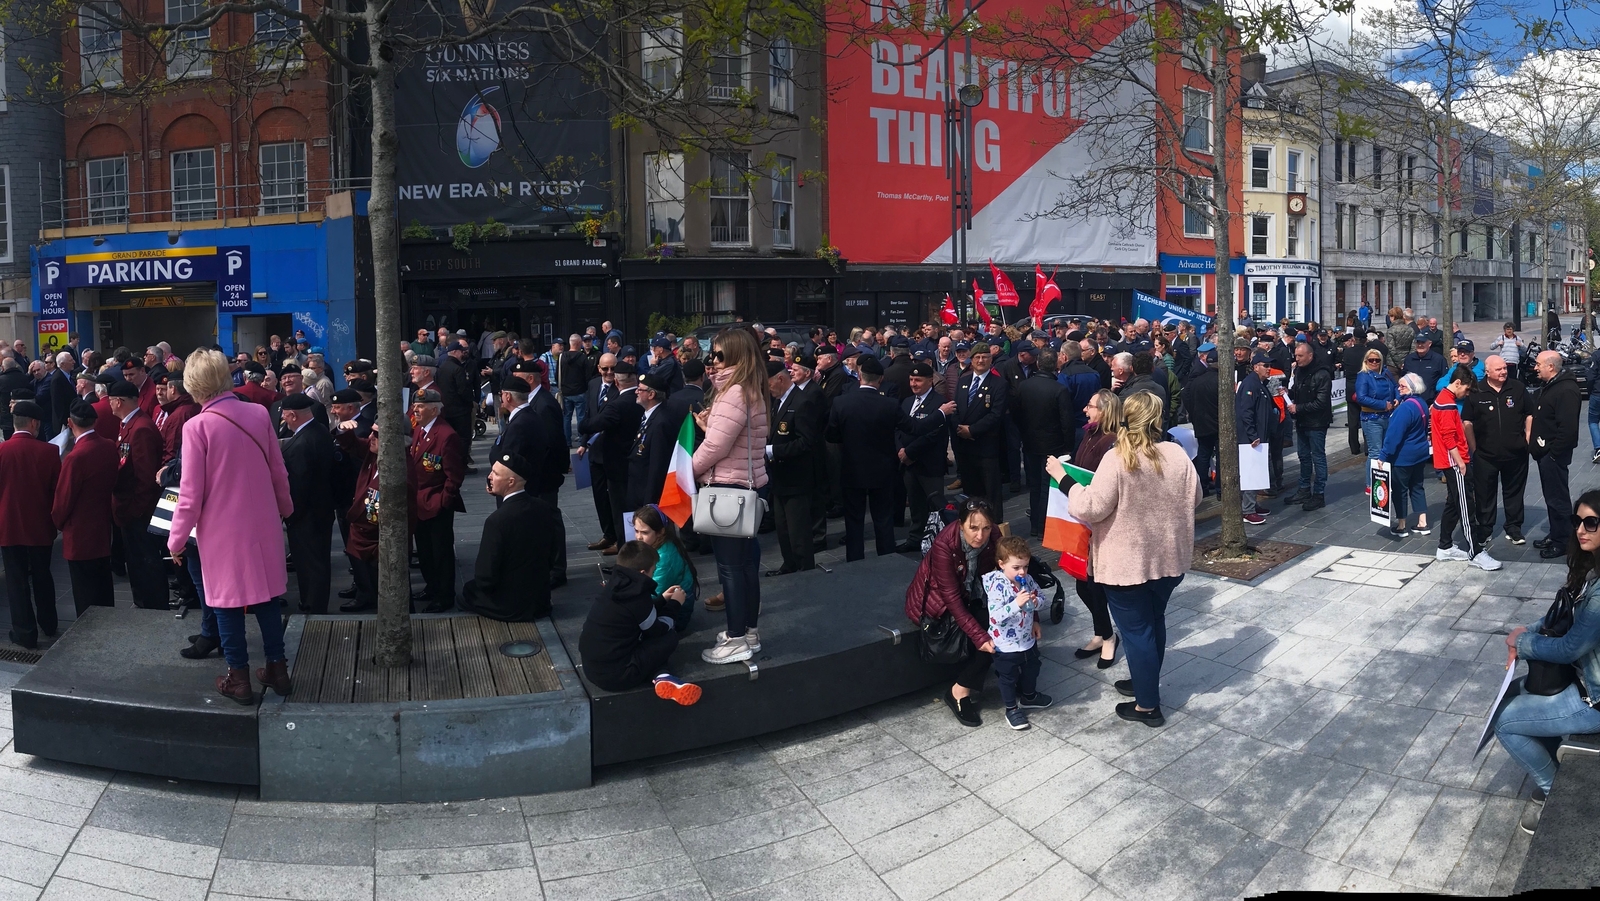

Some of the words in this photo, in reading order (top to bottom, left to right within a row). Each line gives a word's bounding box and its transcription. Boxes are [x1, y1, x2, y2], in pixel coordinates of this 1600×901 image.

[426, 41, 530, 62] GUINNESS
[426, 69, 451, 82] SIX
[456, 66, 530, 81] NATIONS
[871, 39, 1088, 121] BEAUTIFUL
[399, 184, 443, 200] NEW
[449, 183, 487, 198] ERA
[493, 182, 513, 197] IN
[519, 180, 585, 196] RUGBY
[876, 191, 902, 199] Thomas
[903, 192, 934, 202] McCarthy,
[935, 194, 950, 202] Poet
[112, 252, 137, 260] GRAND
[139, 249, 167, 258] PARADE
[228, 255, 243, 275] P
[447, 257, 481, 270] SOUTH
[555, 259, 561, 267] 51
[1178, 260, 1204, 269] Advance
[47, 266, 60, 285] P
[87, 259, 193, 284] PARKING
[222, 299, 249, 307] HOURS
[1136, 293, 1167, 308] TEACHERS'
[1168, 303, 1187, 315] UNION
[42, 307, 66, 315] HOURS
[41, 323, 65, 331] STOP
[48, 335, 58, 347] Q
